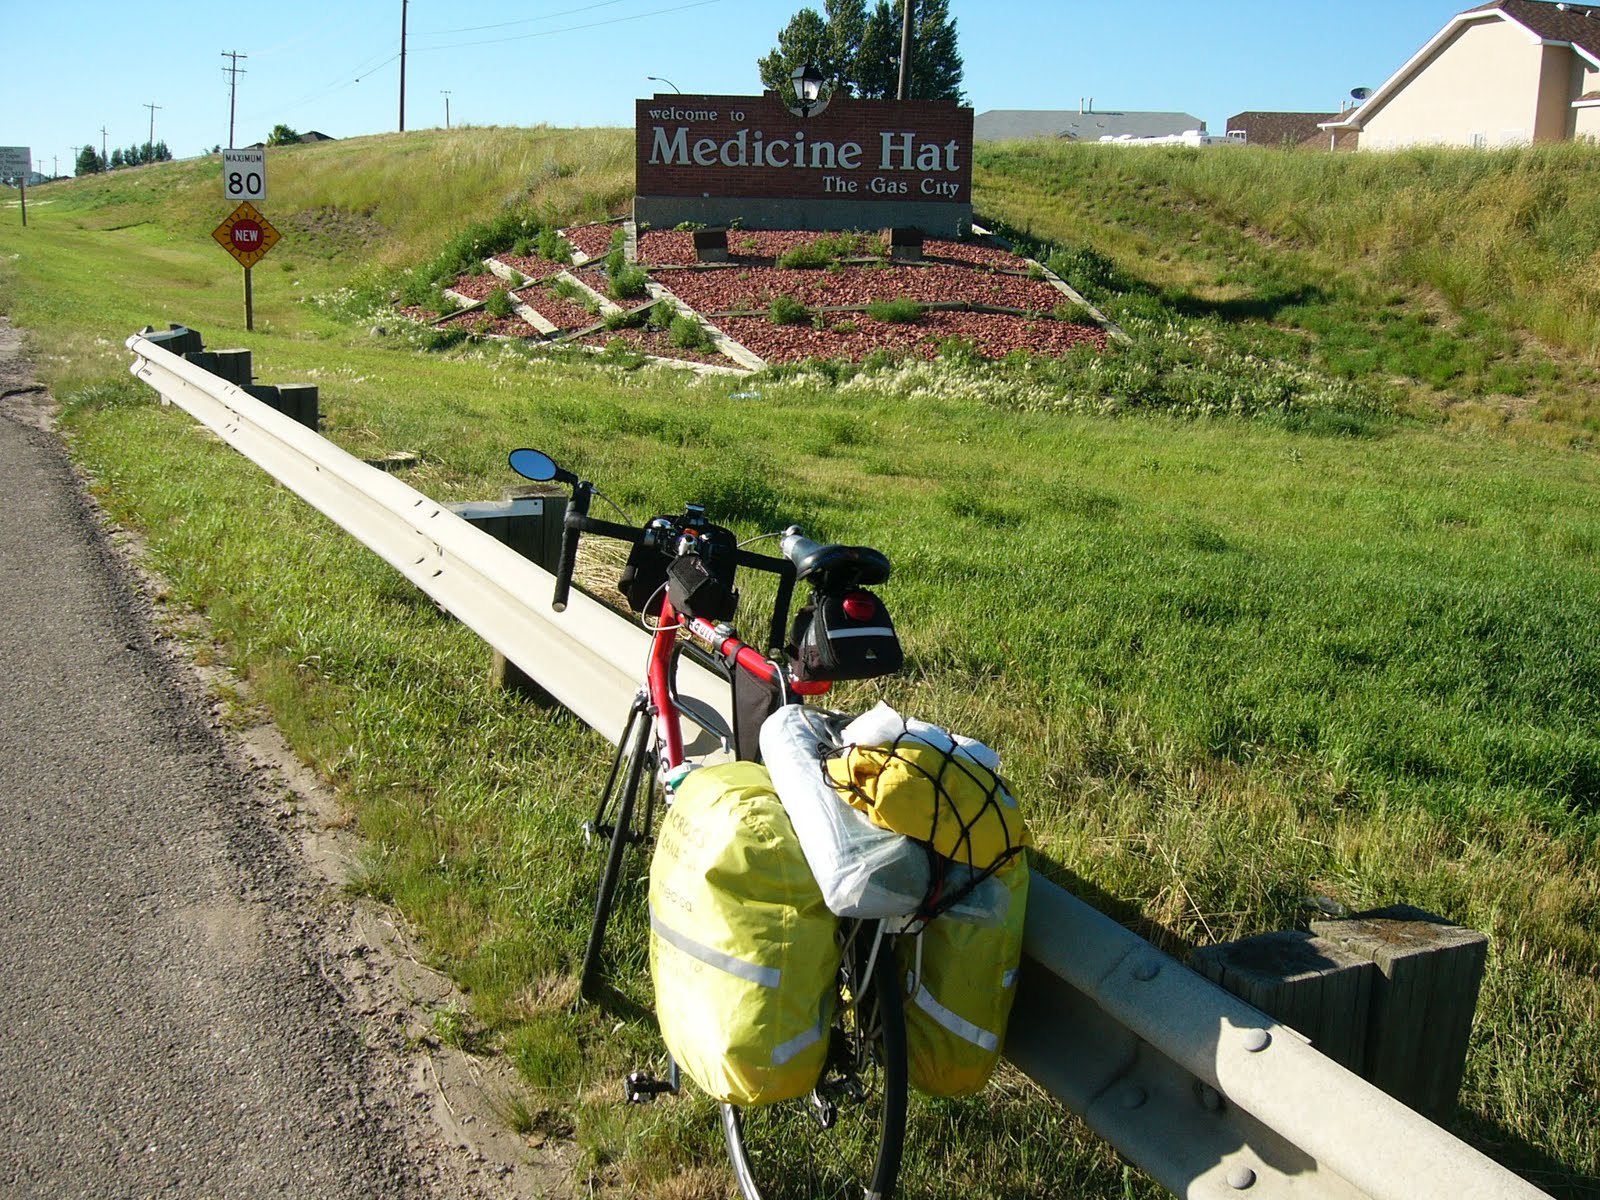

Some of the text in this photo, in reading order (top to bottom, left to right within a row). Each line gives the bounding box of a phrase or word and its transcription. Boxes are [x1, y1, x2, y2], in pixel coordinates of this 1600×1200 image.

[649, 106, 746, 122] welcome to
[225, 153, 263, 163] MAXIMUM
[648, 126, 961, 172] Medicine Hat
[228, 171, 262, 195] 80
[822, 175, 960, 198] The Gas City
[235, 229, 259, 242] NEW
